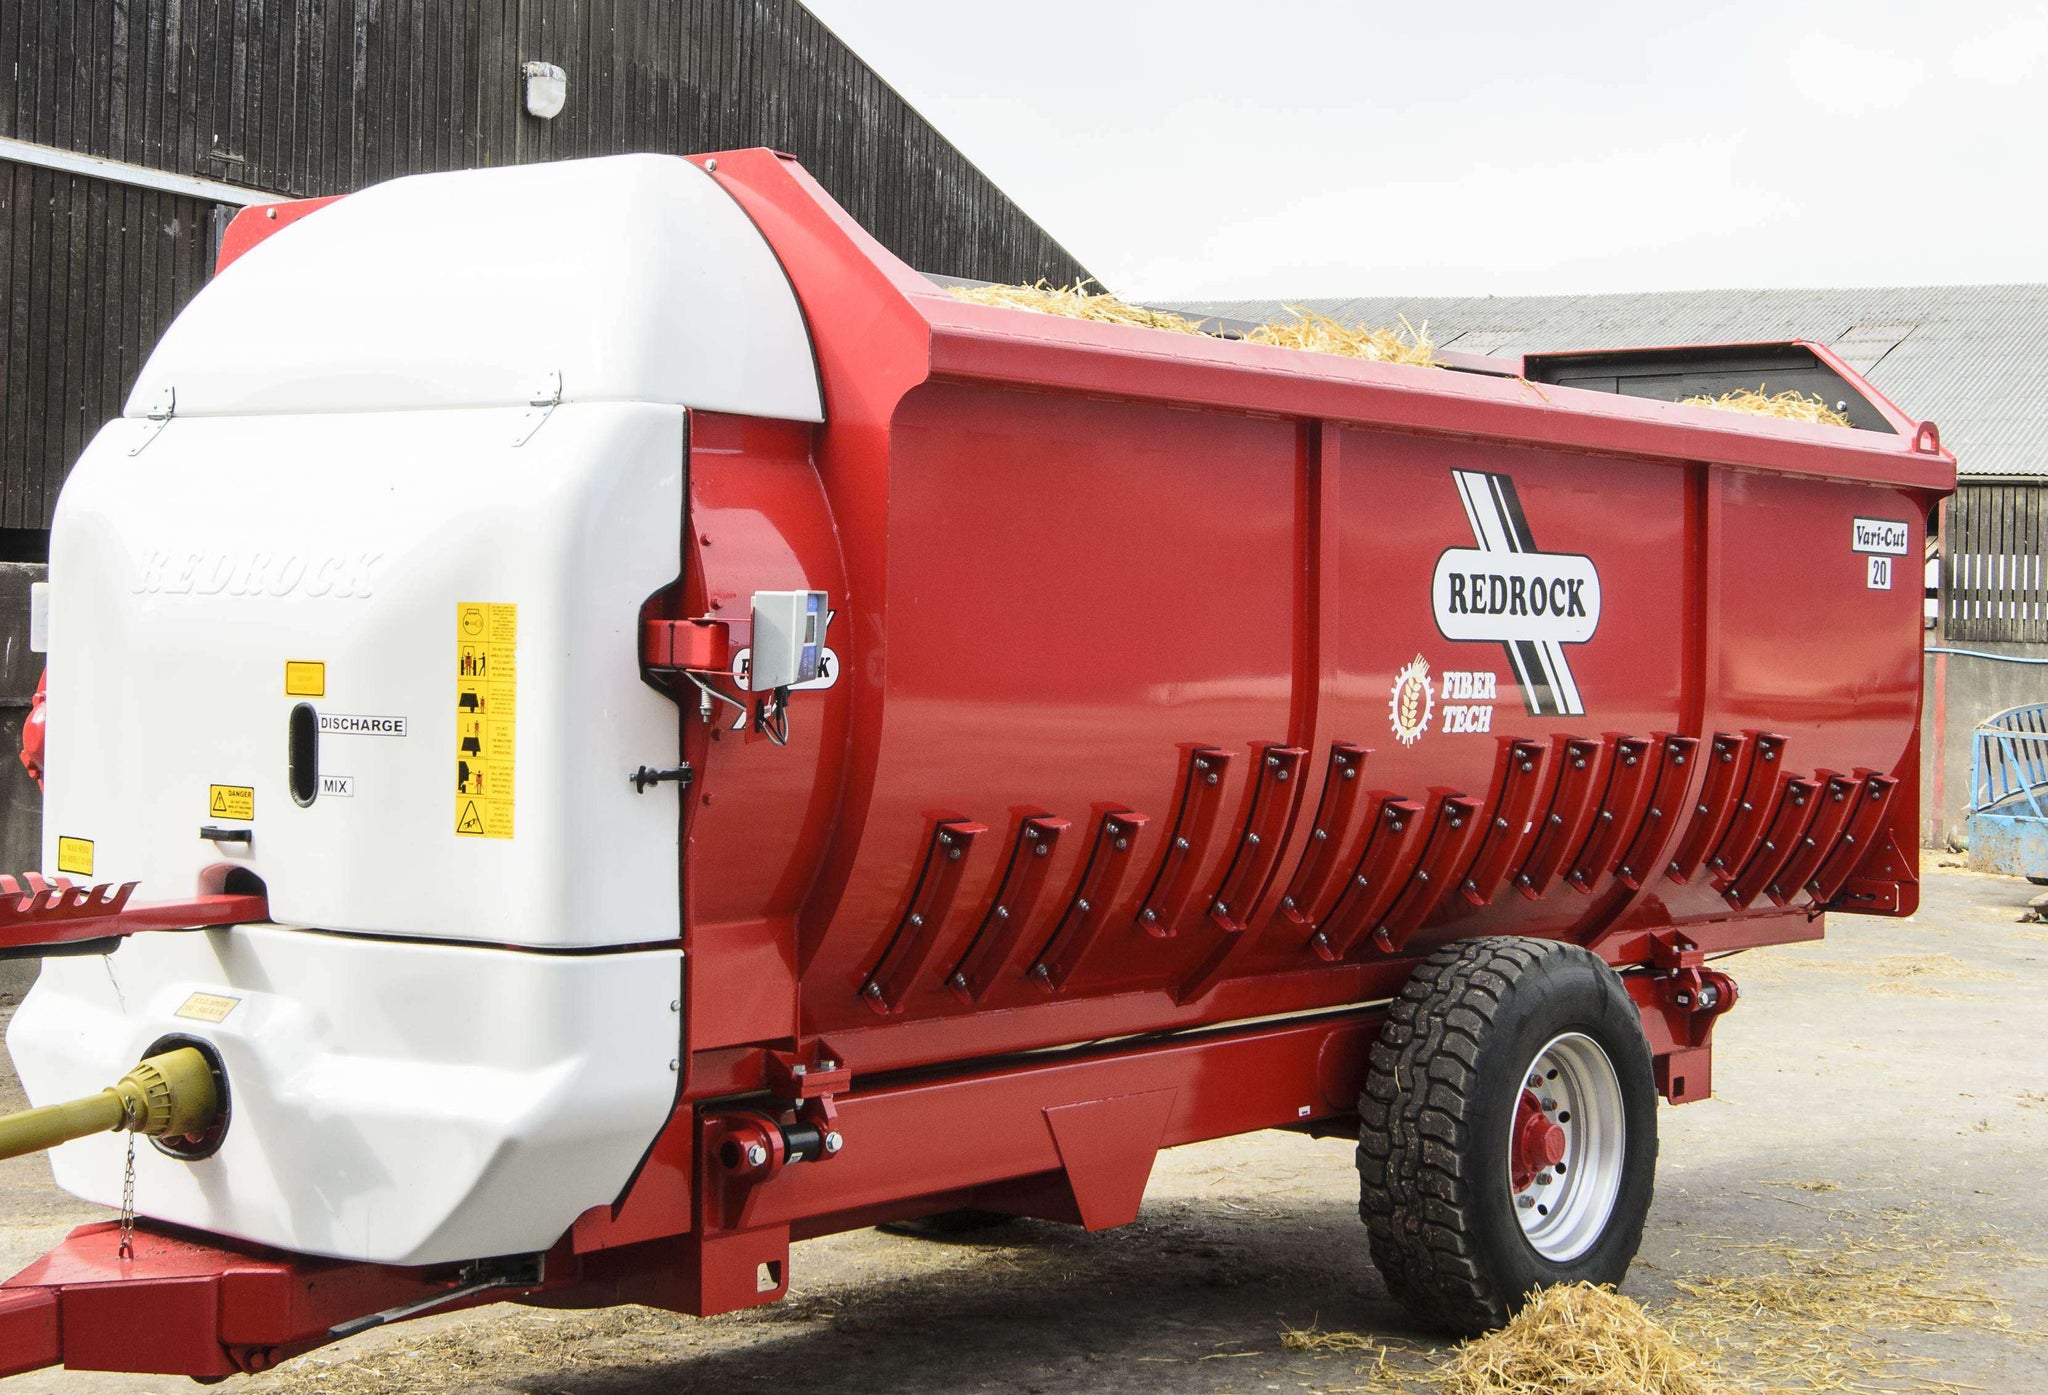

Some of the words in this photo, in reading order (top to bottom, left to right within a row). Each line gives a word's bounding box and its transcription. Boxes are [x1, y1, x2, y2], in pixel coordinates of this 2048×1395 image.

[1856, 525, 1905, 547] Vari-Cut
[130, 551, 385, 599] REDROCK
[1873, 560, 1887, 586] 20
[1448, 572, 1587, 618] REDROCK
[1440, 671, 1497, 700] FIBER
[321, 717, 403, 732] DISCHARGE
[1441, 705, 1493, 733] TECH
[228, 790, 252, 798] DANGER
[324, 779, 347, 793] MIX
